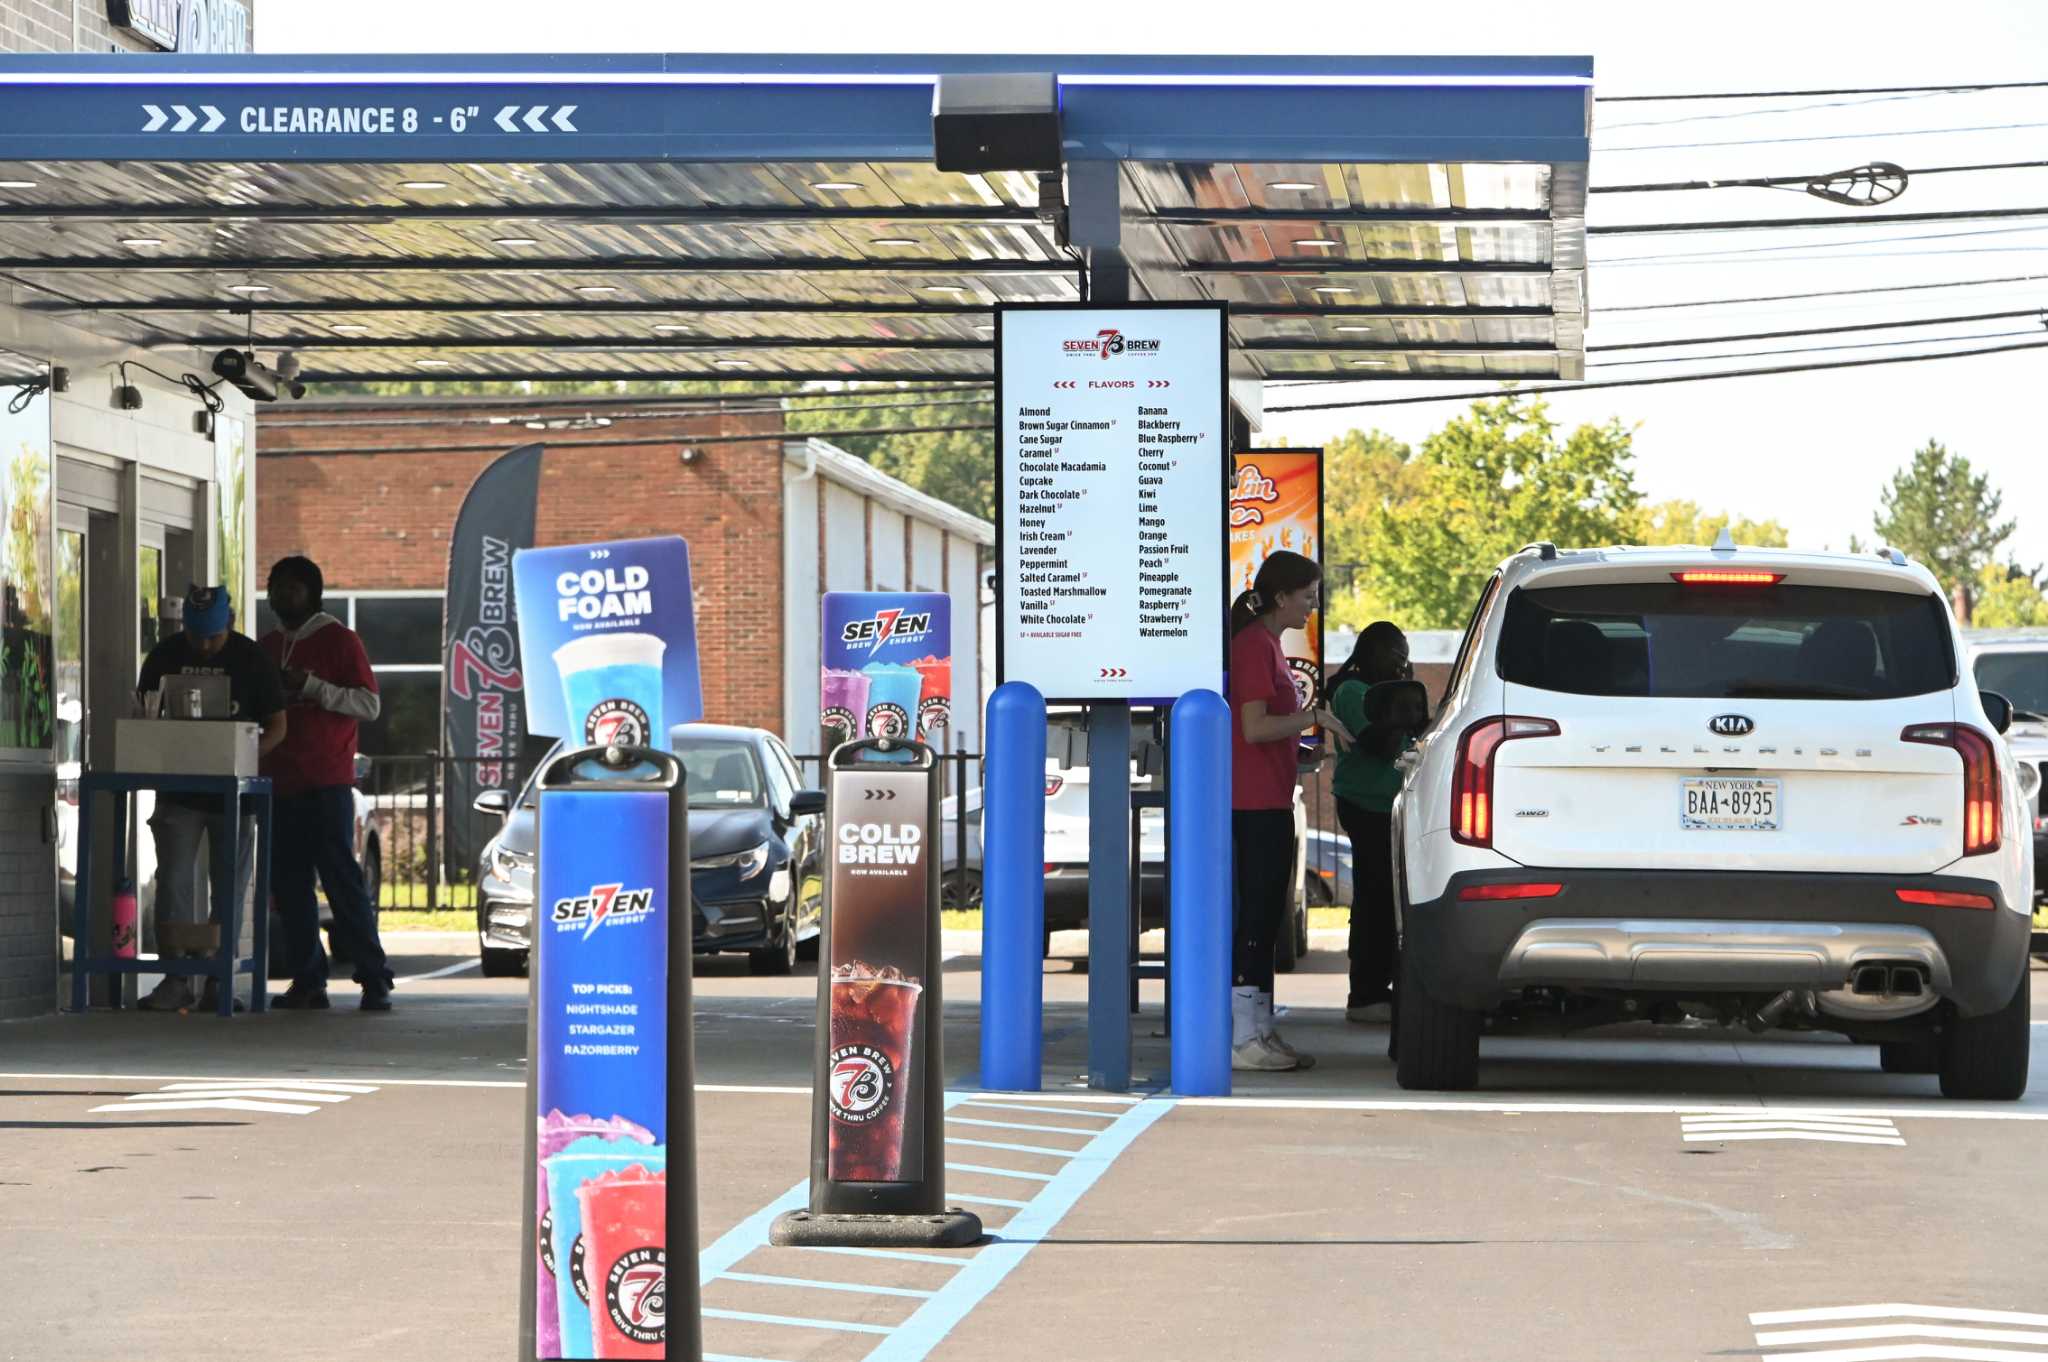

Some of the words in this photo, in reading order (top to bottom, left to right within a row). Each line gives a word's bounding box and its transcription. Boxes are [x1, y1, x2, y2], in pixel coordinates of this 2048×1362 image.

[240, 107, 395, 132] CLEARANCE
[402, 107, 418, 132] 8
[1063, 340, 1100, 351] SEVEN
[1126, 340, 1160, 351] BREW
[1088, 381, 1135, 389] FLAVORS
[1019, 406, 1051, 416] Almond
[1138, 406, 1168, 416] Banana
[1019, 420, 1045, 430] Brown
[1046, 420, 1069, 431] Sugar
[1070, 420, 1110, 430] Cinnamon
[1138, 419, 1180, 430] Blackberry
[1019, 435, 1038, 444] Cane
[1040, 435, 1062, 445] Sugar
[1138, 434, 1156, 443] Blue
[1157, 433, 1198, 444] Raspberry
[1019, 448, 1052, 458] Caramel
[1138, 448, 1164, 458] Cherry
[1019, 462, 1059, 472] Chocolate
[1061, 462, 1106, 471] Macadamia
[1138, 461, 1170, 471] Coconut
[1019, 476, 1053, 487] Cupcake
[1138, 475, 1163, 485] Guava
[1019, 490, 1039, 499] Dark
[1040, 489, 1080, 499] Chocolate
[1138, 489, 1156, 499] Kiwi
[1019, 504, 1056, 513] Hazelnut
[1138, 503, 1158, 512] Lime
[1020, 518, 1045, 528] Honey
[1139, 517, 1165, 527] Mango
[1020, 531, 1038, 541] Irish
[1040, 531, 1065, 541] Cream
[1139, 531, 1167, 542] Orange
[1020, 546, 1057, 555] Lavender
[1139, 544, 1169, 554] Passion
[1170, 544, 1189, 554] Fruit
[1020, 559, 1068, 570] Peppermint
[1139, 558, 1162, 568] Peach
[480, 535, 509, 624] BREW
[556, 566, 649, 597] COLD
[1020, 573, 1045, 582] Salted
[1047, 573, 1080, 582] Caramel
[1139, 572, 1179, 583] Pineapple
[1020, 587, 1051, 596] Toasted
[1053, 586, 1107, 596] Marshmallow
[1139, 586, 1192, 597] Pomegranate
[557, 590, 652, 622] FOAM
[1020, 601, 1048, 610] Vanilla
[1139, 600, 1180, 611] Raspberry
[1020, 614, 1044, 624] White
[1046, 614, 1086, 624] Chocolate
[1139, 614, 1183, 625] Strawberry
[1139, 628, 1188, 638] Watermelon
[1715, 718, 1749, 732] KIA
[476, 692, 503, 787] SEVEN
[1706, 782, 1728, 790] NEW
[1730, 782, 1755, 790] YORK
[839, 823, 921, 845] COLD
[839, 845, 920, 865] BREW
[572, 983, 595, 995] TOP
[597, 983, 633, 995] PICKS:
[566, 1004, 639, 1016] NIGHTSHADE
[568, 1024, 636, 1036] STARGAZER
[563, 1045, 640, 1057] RAZORBERRY
[863, 1047, 892, 1074] BREW
[843, 1112, 865, 1122] THRU
[609, 1250, 650, 1283] SEVEN
[611, 1308, 632, 1335] DRIVE
[633, 1329, 658, 1341] THRU
